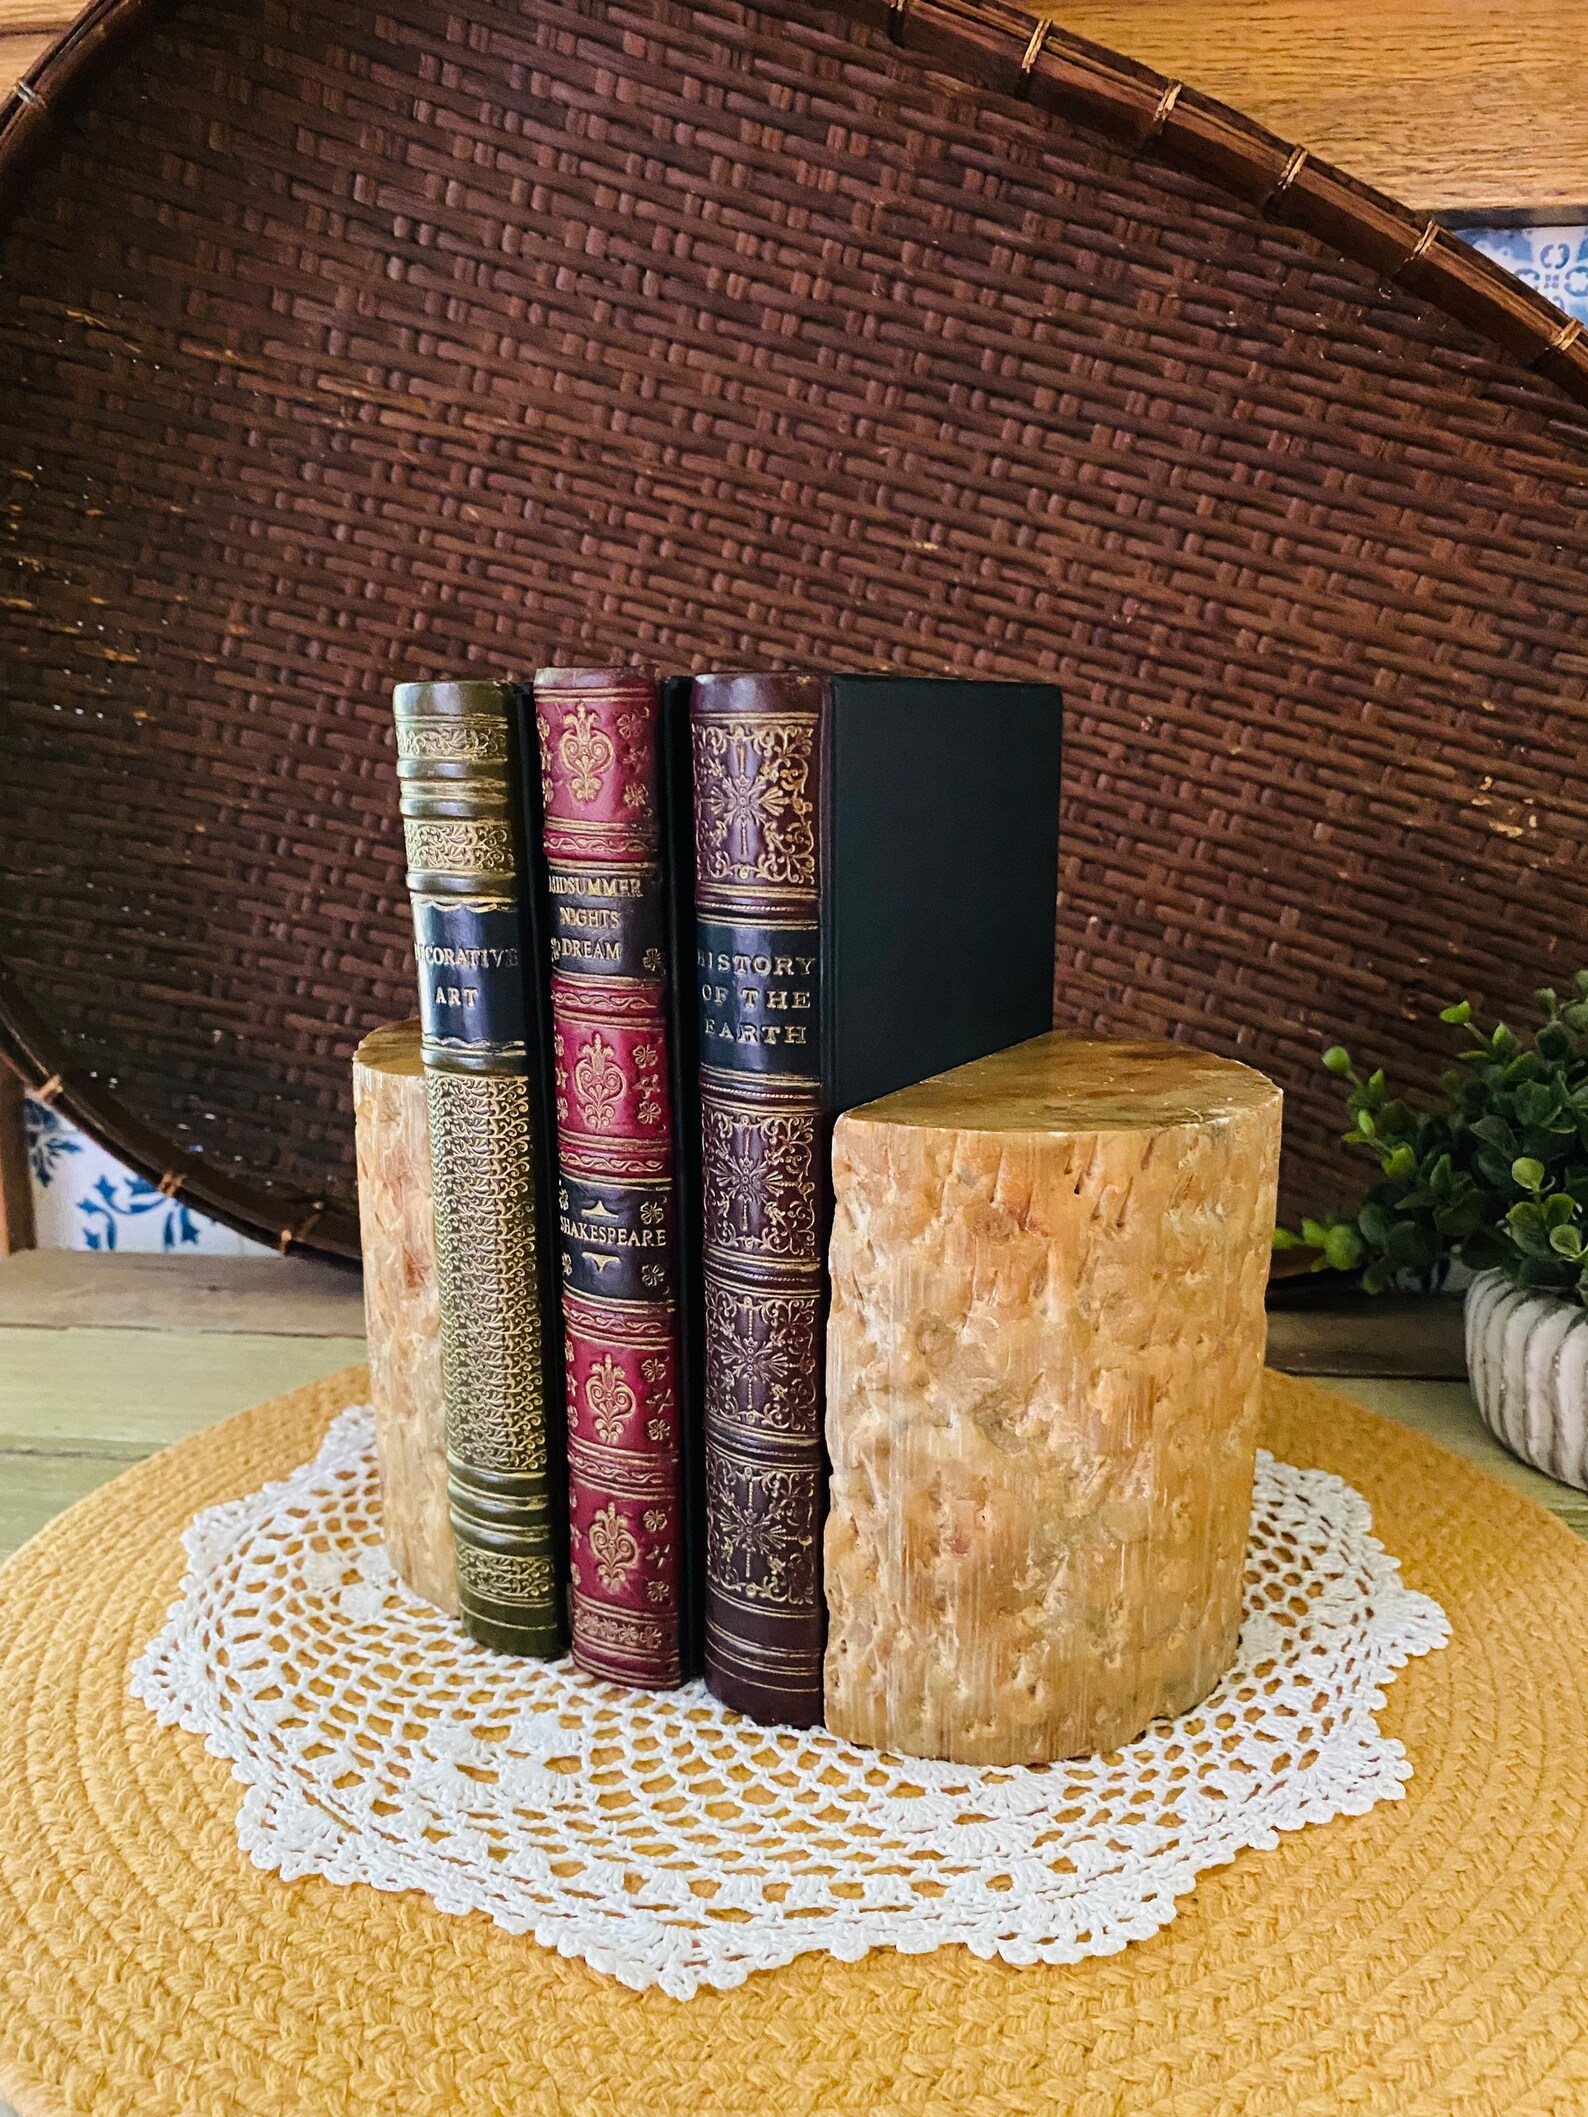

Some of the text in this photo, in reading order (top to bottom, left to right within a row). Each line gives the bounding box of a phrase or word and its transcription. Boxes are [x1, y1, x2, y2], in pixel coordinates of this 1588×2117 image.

[559, 906, 620, 929] NIGHTS
[561, 937, 621, 961] DREAM
[436, 986, 478, 1007] ART
[702, 984, 811, 1011] OF THE
[705, 1018, 807, 1045] EARTH
[560, 1215, 667, 1247] SHAKESPEARE
